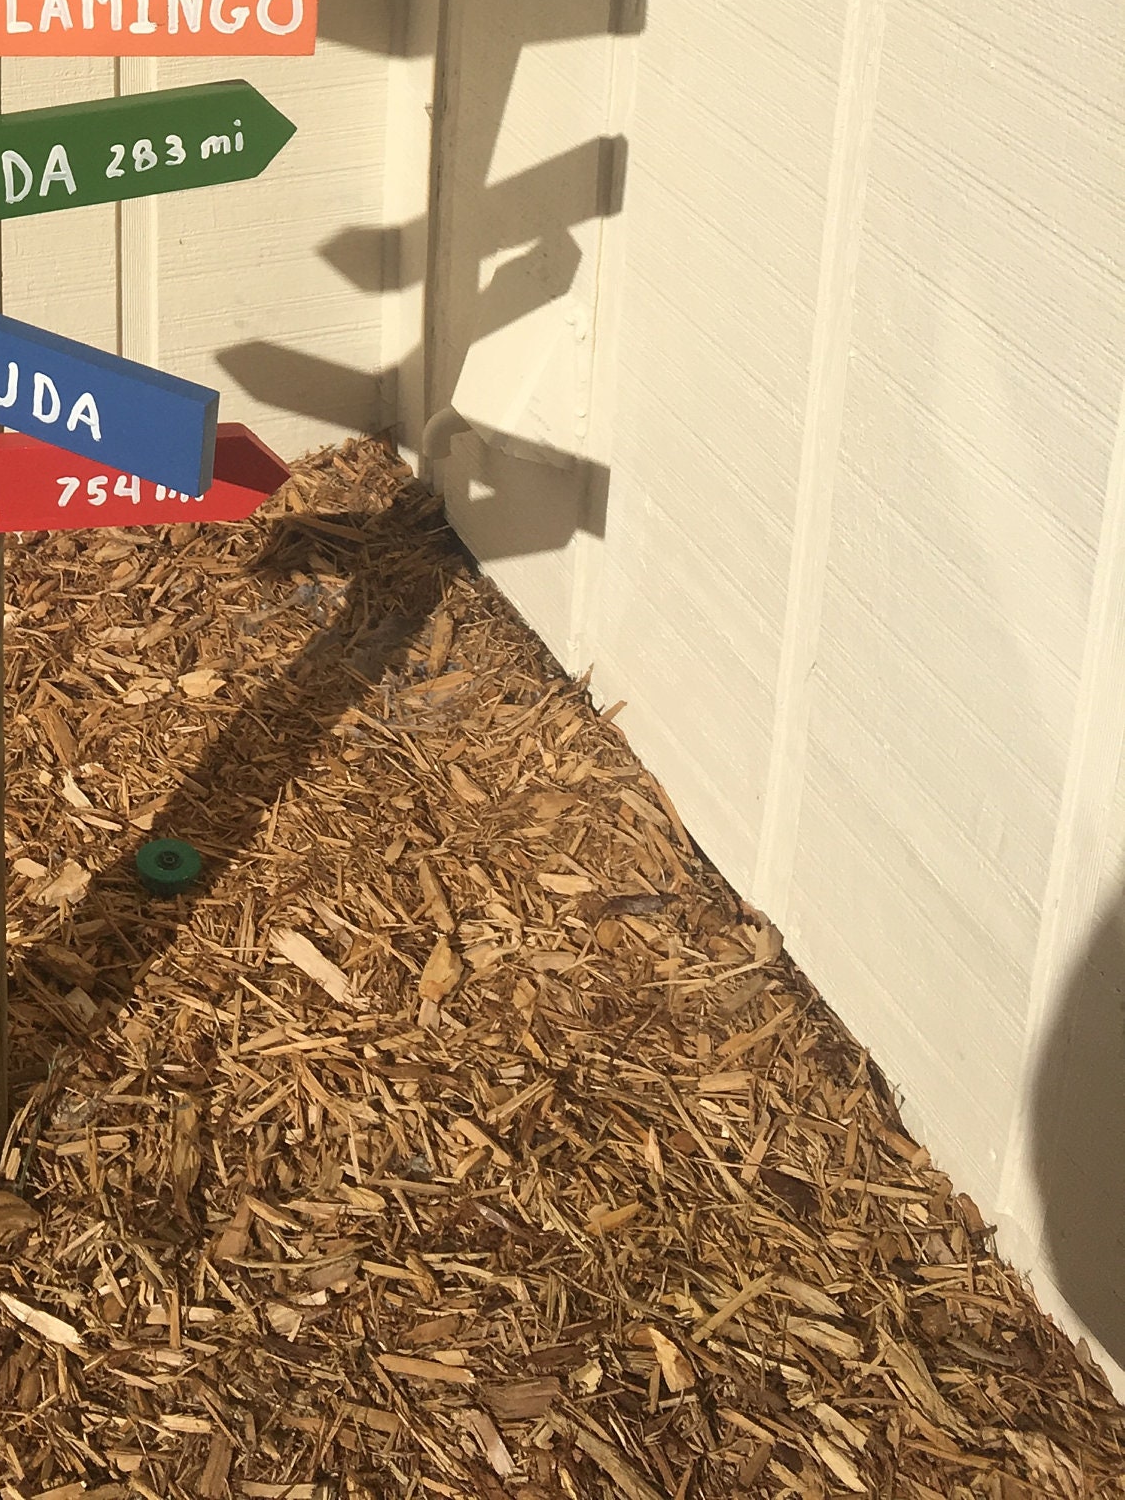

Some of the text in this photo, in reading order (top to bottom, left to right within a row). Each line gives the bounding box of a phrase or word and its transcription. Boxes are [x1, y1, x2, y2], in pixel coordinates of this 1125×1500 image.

[104, 133, 187, 178] 283
[200, 119, 245, 159] mi
[56, 474, 141, 507] 754
